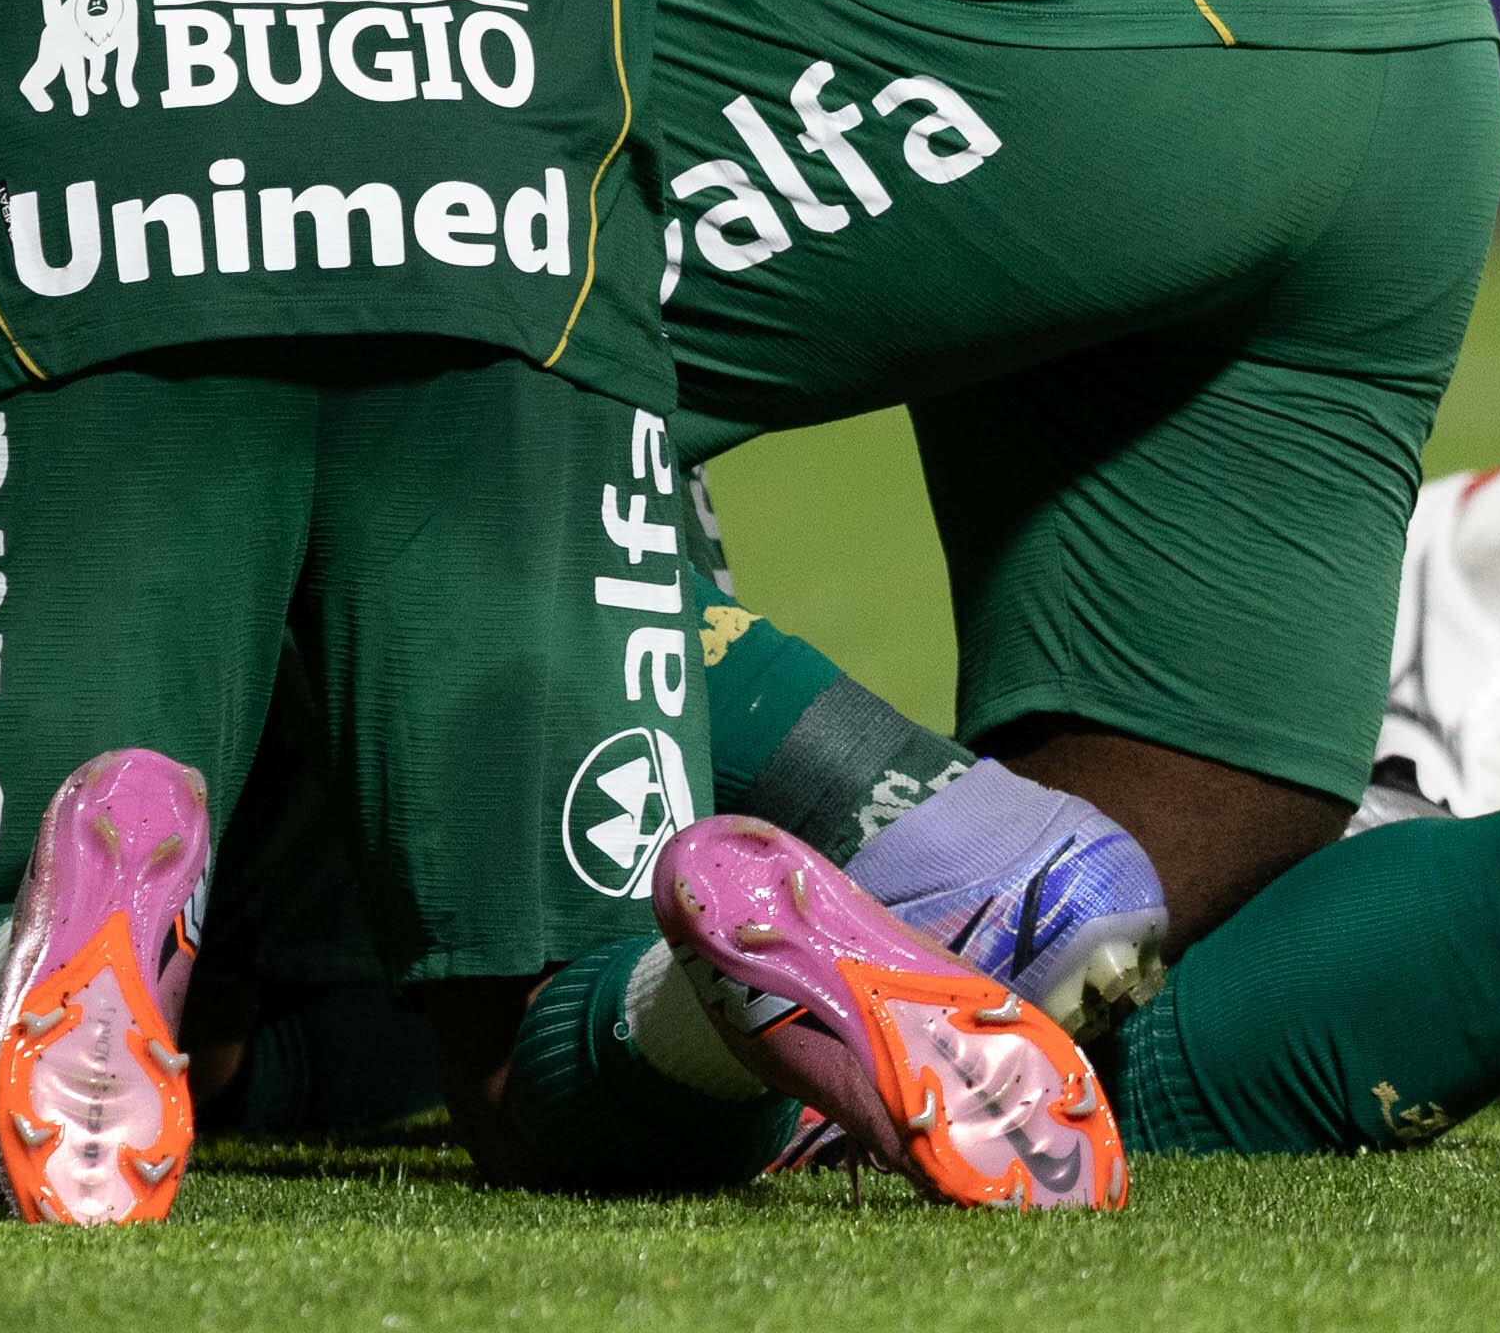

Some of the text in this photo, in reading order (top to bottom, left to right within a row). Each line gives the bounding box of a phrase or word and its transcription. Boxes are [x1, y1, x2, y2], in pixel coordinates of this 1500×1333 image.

[153, 4, 537, 109] BUGIO
[8, 158, 572, 298] Unimed
[669, 59, 1004, 273] alfa
[594, 407, 687, 719] alfa
